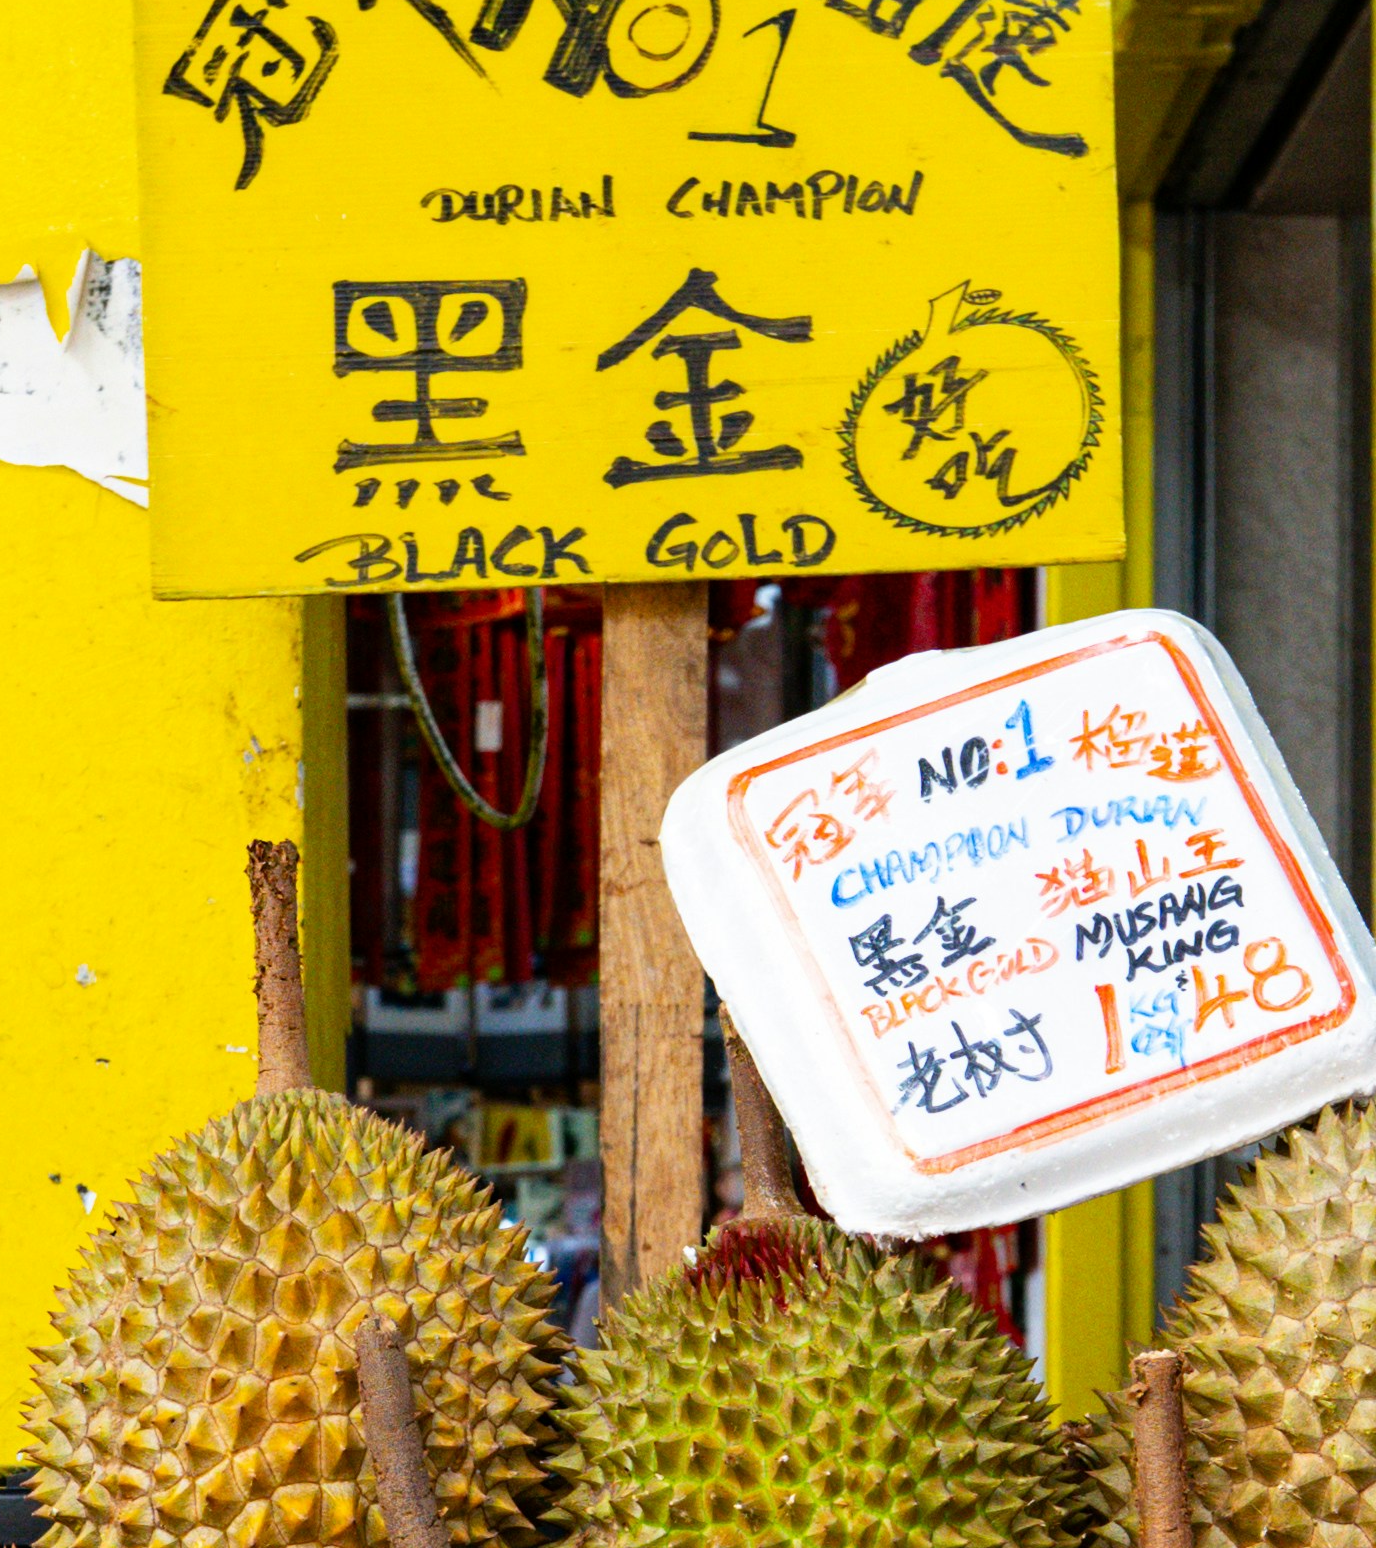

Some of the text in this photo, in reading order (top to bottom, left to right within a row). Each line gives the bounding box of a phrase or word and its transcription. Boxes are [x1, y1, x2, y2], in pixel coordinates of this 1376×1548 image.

[421, 169, 924, 226] DURIAN CHAMPION
[332, 268, 814, 508] 黑金
[882, 355, 1066, 506] 好吃
[295, 512, 837, 587] BLACK GOLD
[831, 793, 1208, 909] CHAMPION DURIAN
[1034, 828, 1246, 919] 猫山王
[848, 895, 997, 997] 黑金
[1076, 875, 1245, 961] MUSANG
[1126, 919, 1240, 982] KING
[861, 975, 969, 1039] BLACK
[891, 1008, 1054, 1114] 老树
